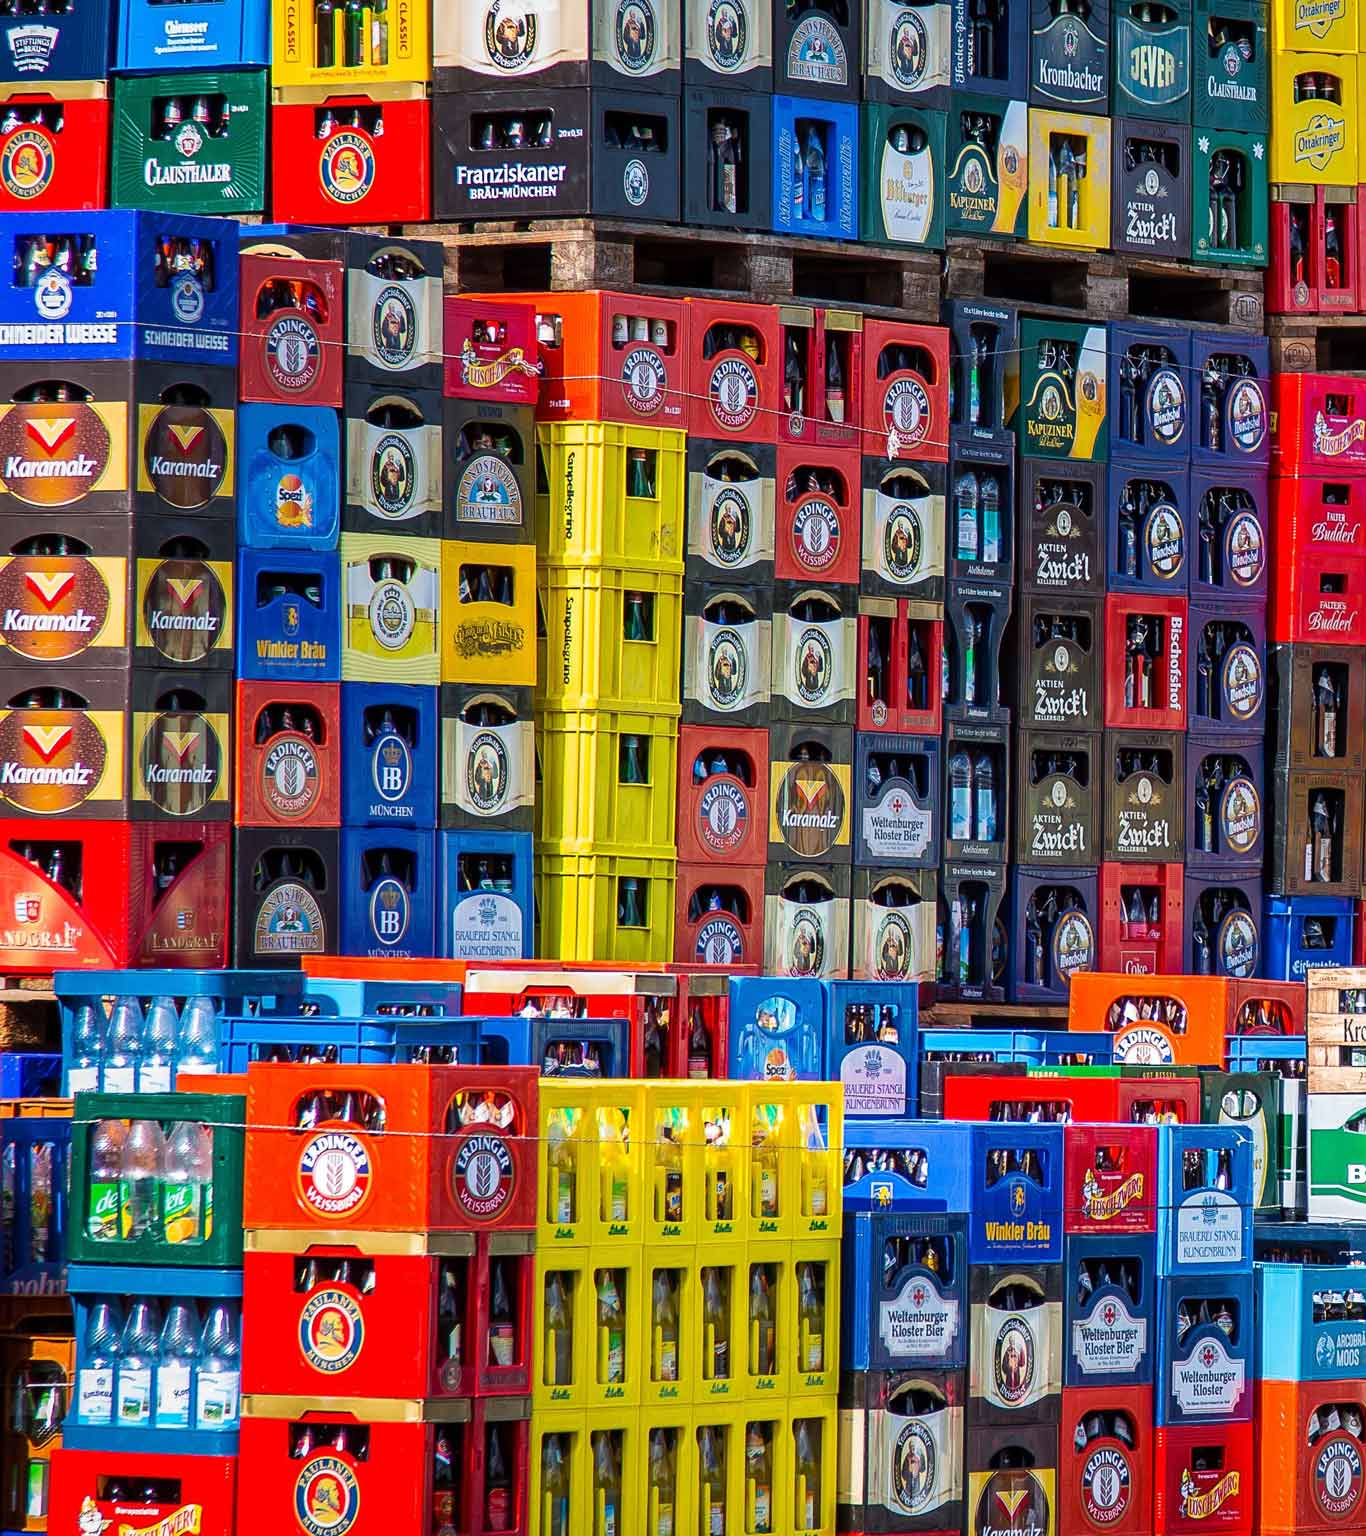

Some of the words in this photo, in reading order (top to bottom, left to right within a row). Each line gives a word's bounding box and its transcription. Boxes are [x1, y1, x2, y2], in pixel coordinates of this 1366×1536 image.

[400, 2, 408, 52] CLASSIC
[1040, 59, 1103, 92] Krombacher
[1131, 45, 1176, 89] JEVER
[1208, 75, 1257, 101] CLAUSTHALER
[3, 129, 53, 159] PAULANER
[1298, 130, 1341, 152] Ottakringer
[144, 158, 231, 186] CLAUSTHALER
[457, 163, 567, 186] Franziskaner
[469, 184, 557, 200] BRÄU-MÜNCHEN
[950, 191, 996, 211] KAPUZINER
[1127, 202, 1154, 212] AKTIEN
[269, 319, 317, 349] ERDINGER
[623, 349, 665, 376] ERDINGER
[712, 360, 755, 392] ERDINGER
[886, 379, 926, 409] ERDINGER
[1027, 420, 1073, 439] KAPUZINER
[5, 455, 97, 478] Karamalz
[151, 457, 220, 478] Karamalz
[279, 488, 302, 503] Spezi
[463, 504, 518, 521] BRAUHAUS
[795, 501, 838, 530] ERDINGER
[1326, 511, 1345, 522] FALTER
[1312, 521, 1360, 544] Budderl
[1037, 543, 1067, 553] AKTIEN
[3, 609, 97, 633] Karamalz
[151, 611, 220, 631] Karamalz
[257, 639, 298, 659] Winkler
[300, 640, 326, 659] Bräu
[1170, 615, 1183, 709] Bischofshof
[1035, 679, 1064, 689] AKTIEN
[267, 743, 315, 773] ERDINGER
[2, 763, 93, 786] Karamalz
[146, 764, 217, 784] Karamalz
[379, 765, 403, 790] HB
[702, 782, 746, 813] ERDINGER
[369, 803, 415, 818] MÜNCHEN
[782, 809, 839, 829] Karamalz
[1032, 816, 1062, 824] AKTIEN
[1119, 811, 1147, 821] AKTIEN
[871, 816, 924, 831] Weltenburger
[873, 829, 905, 842] Kloster
[906, 830, 921, 841] Bier
[0, 926, 77, 948] NDGRAF
[455, 930, 490, 941] BRAUEREI
[491, 930, 520, 941] STANGL
[697, 920, 740, 950] ERDINGER
[1116, 1029, 1171, 1061] ERDINGER
[301, 1133, 369, 1166] ERDINGER
[457, 1136, 510, 1168] ERDINGER
[985, 1221, 1025, 1241] Winkler
[1027, 1221, 1050, 1241] Bräu
[303, 1292, 361, 1320] PAULANER
[887, 1310, 948, 1325] Weltenburger
[891, 1324, 924, 1338] Kloster
[926, 1326, 945, 1337] Bier
[1080, 1327, 1138, 1342] Weltenburger
[1084, 1341, 1115, 1355] Kloster
[1116, 1342, 1135, 1354] Bier
[1336, 1349, 1360, 1367] MOOS
[1180, 1370, 1236, 1385] Weltenburger
[1193, 1384, 1224, 1397] Kloster
[1085, 1449, 1128, 1480] ERDINGER
[1319, 1441, 1360, 1472] ERDINGER
[299, 1460, 356, 1489] PAULANER
